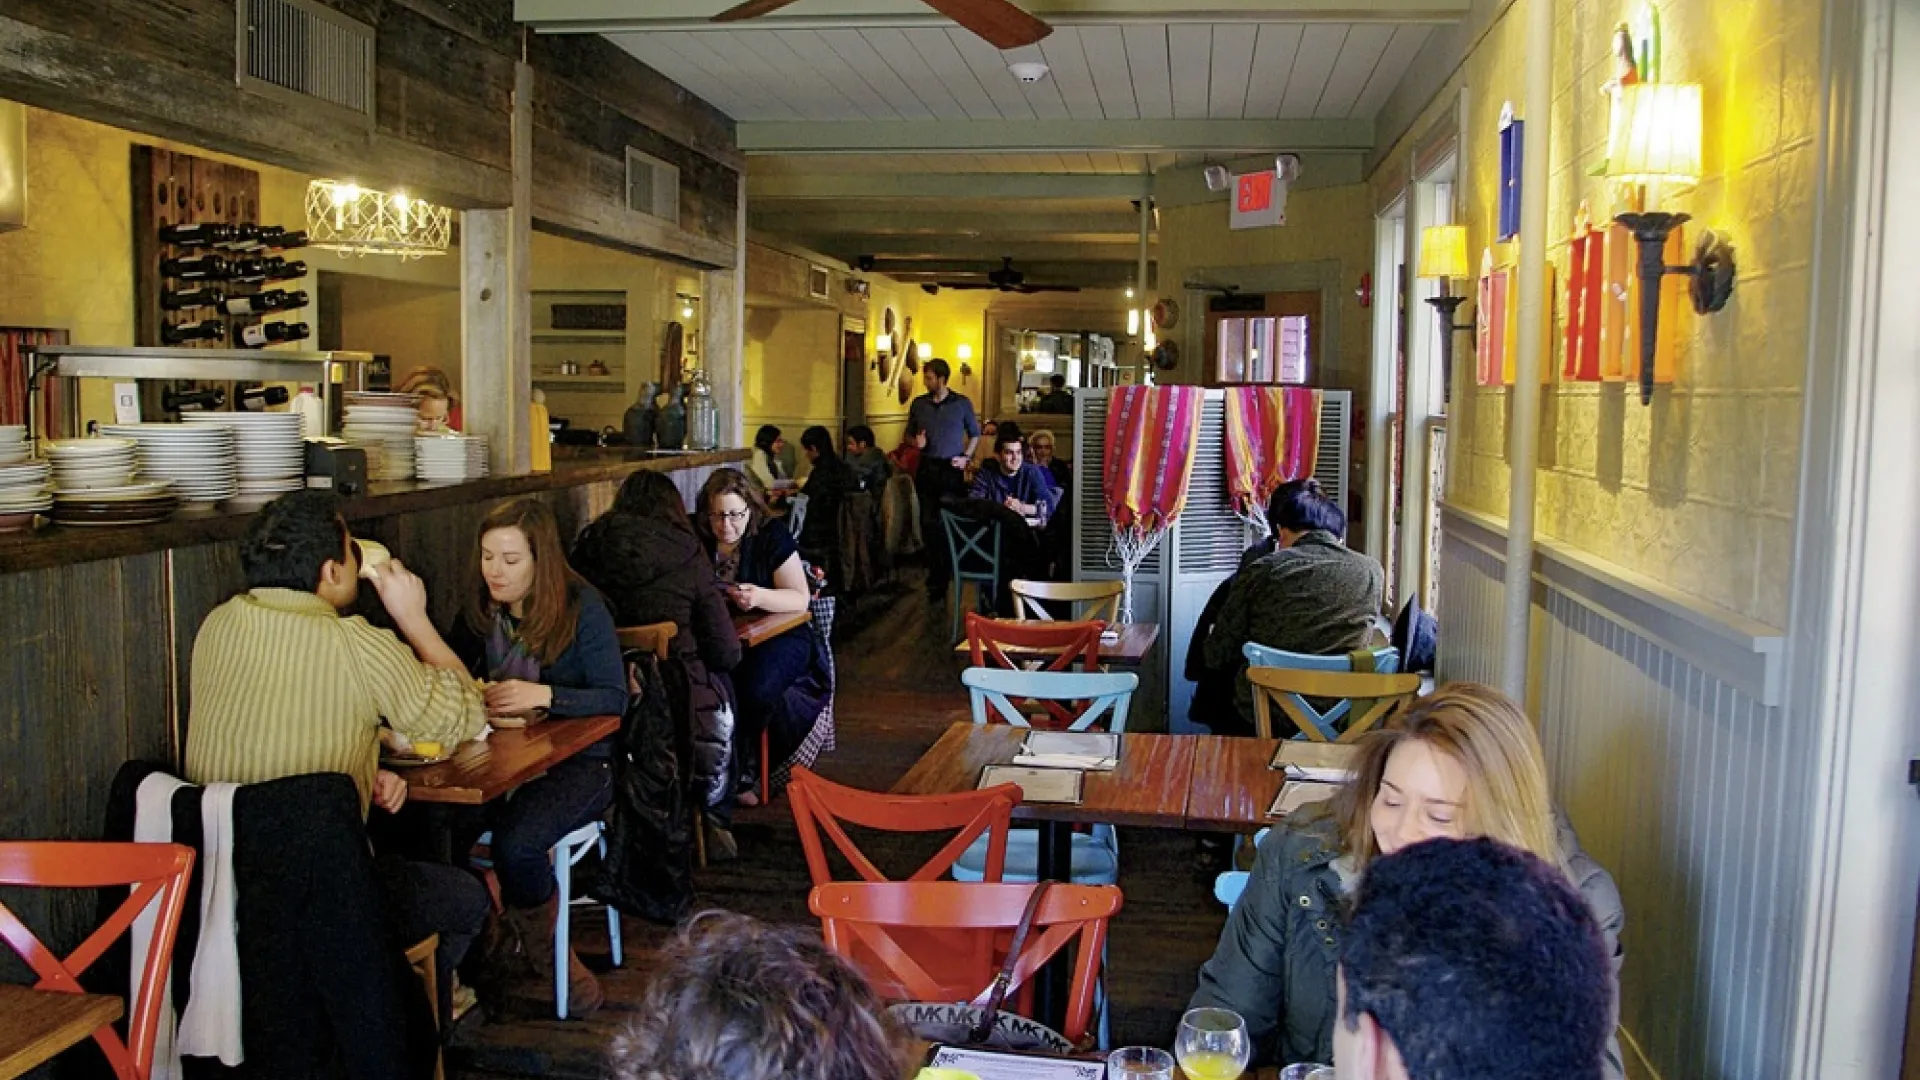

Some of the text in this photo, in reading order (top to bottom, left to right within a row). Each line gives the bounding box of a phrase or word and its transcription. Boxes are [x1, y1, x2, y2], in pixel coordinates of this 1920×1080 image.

[916, 1007, 944, 1023] MK
[948, 1007, 976, 1025] MK
[1012, 1019, 1040, 1037] MK
